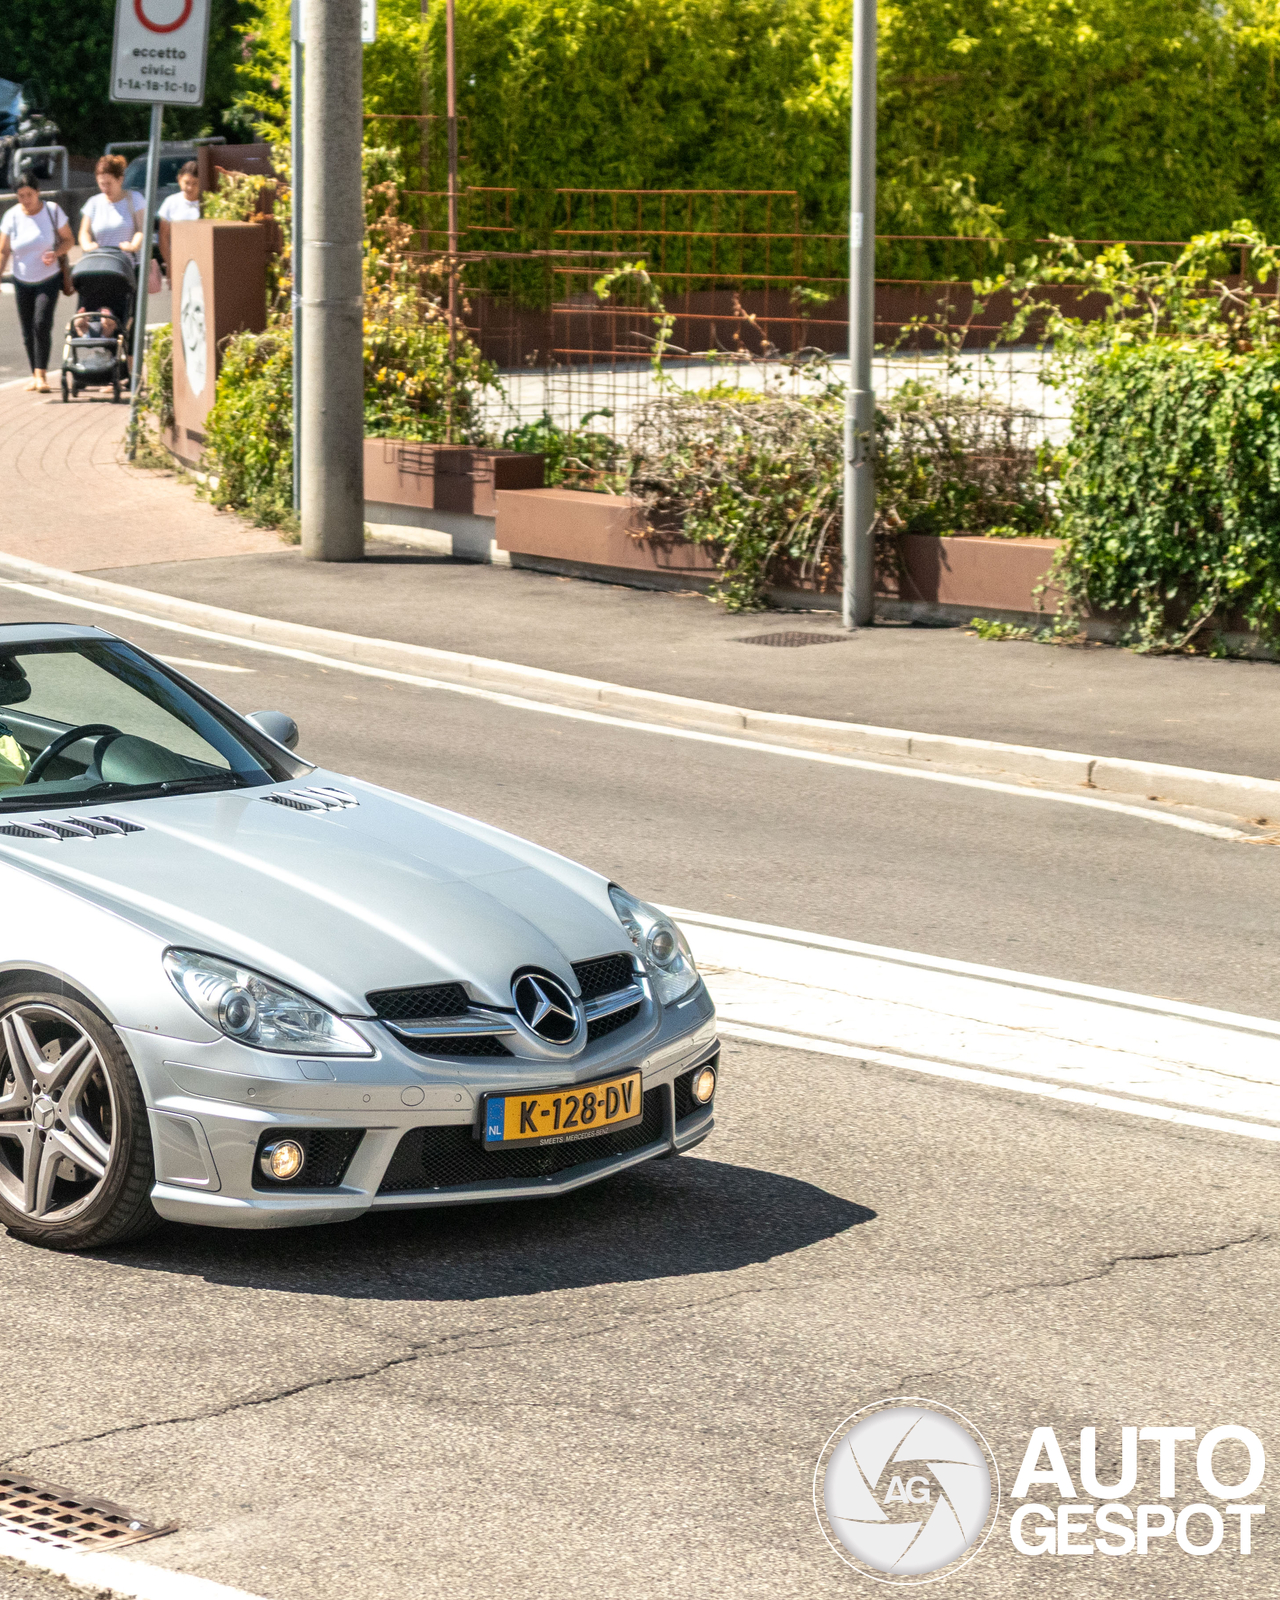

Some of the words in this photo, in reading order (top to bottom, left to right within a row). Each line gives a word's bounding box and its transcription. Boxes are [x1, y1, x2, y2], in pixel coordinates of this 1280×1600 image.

[133, 48, 186, 59] eccetto
[141, 65, 176, 76] civici
[520, 1080, 634, 1134] K-128-DV
[488, 1125, 502, 1136] NL
[539, 1137, 564, 1146] SMEETS
[565, 1127, 610, 1143] MERCEDES-BENZ
